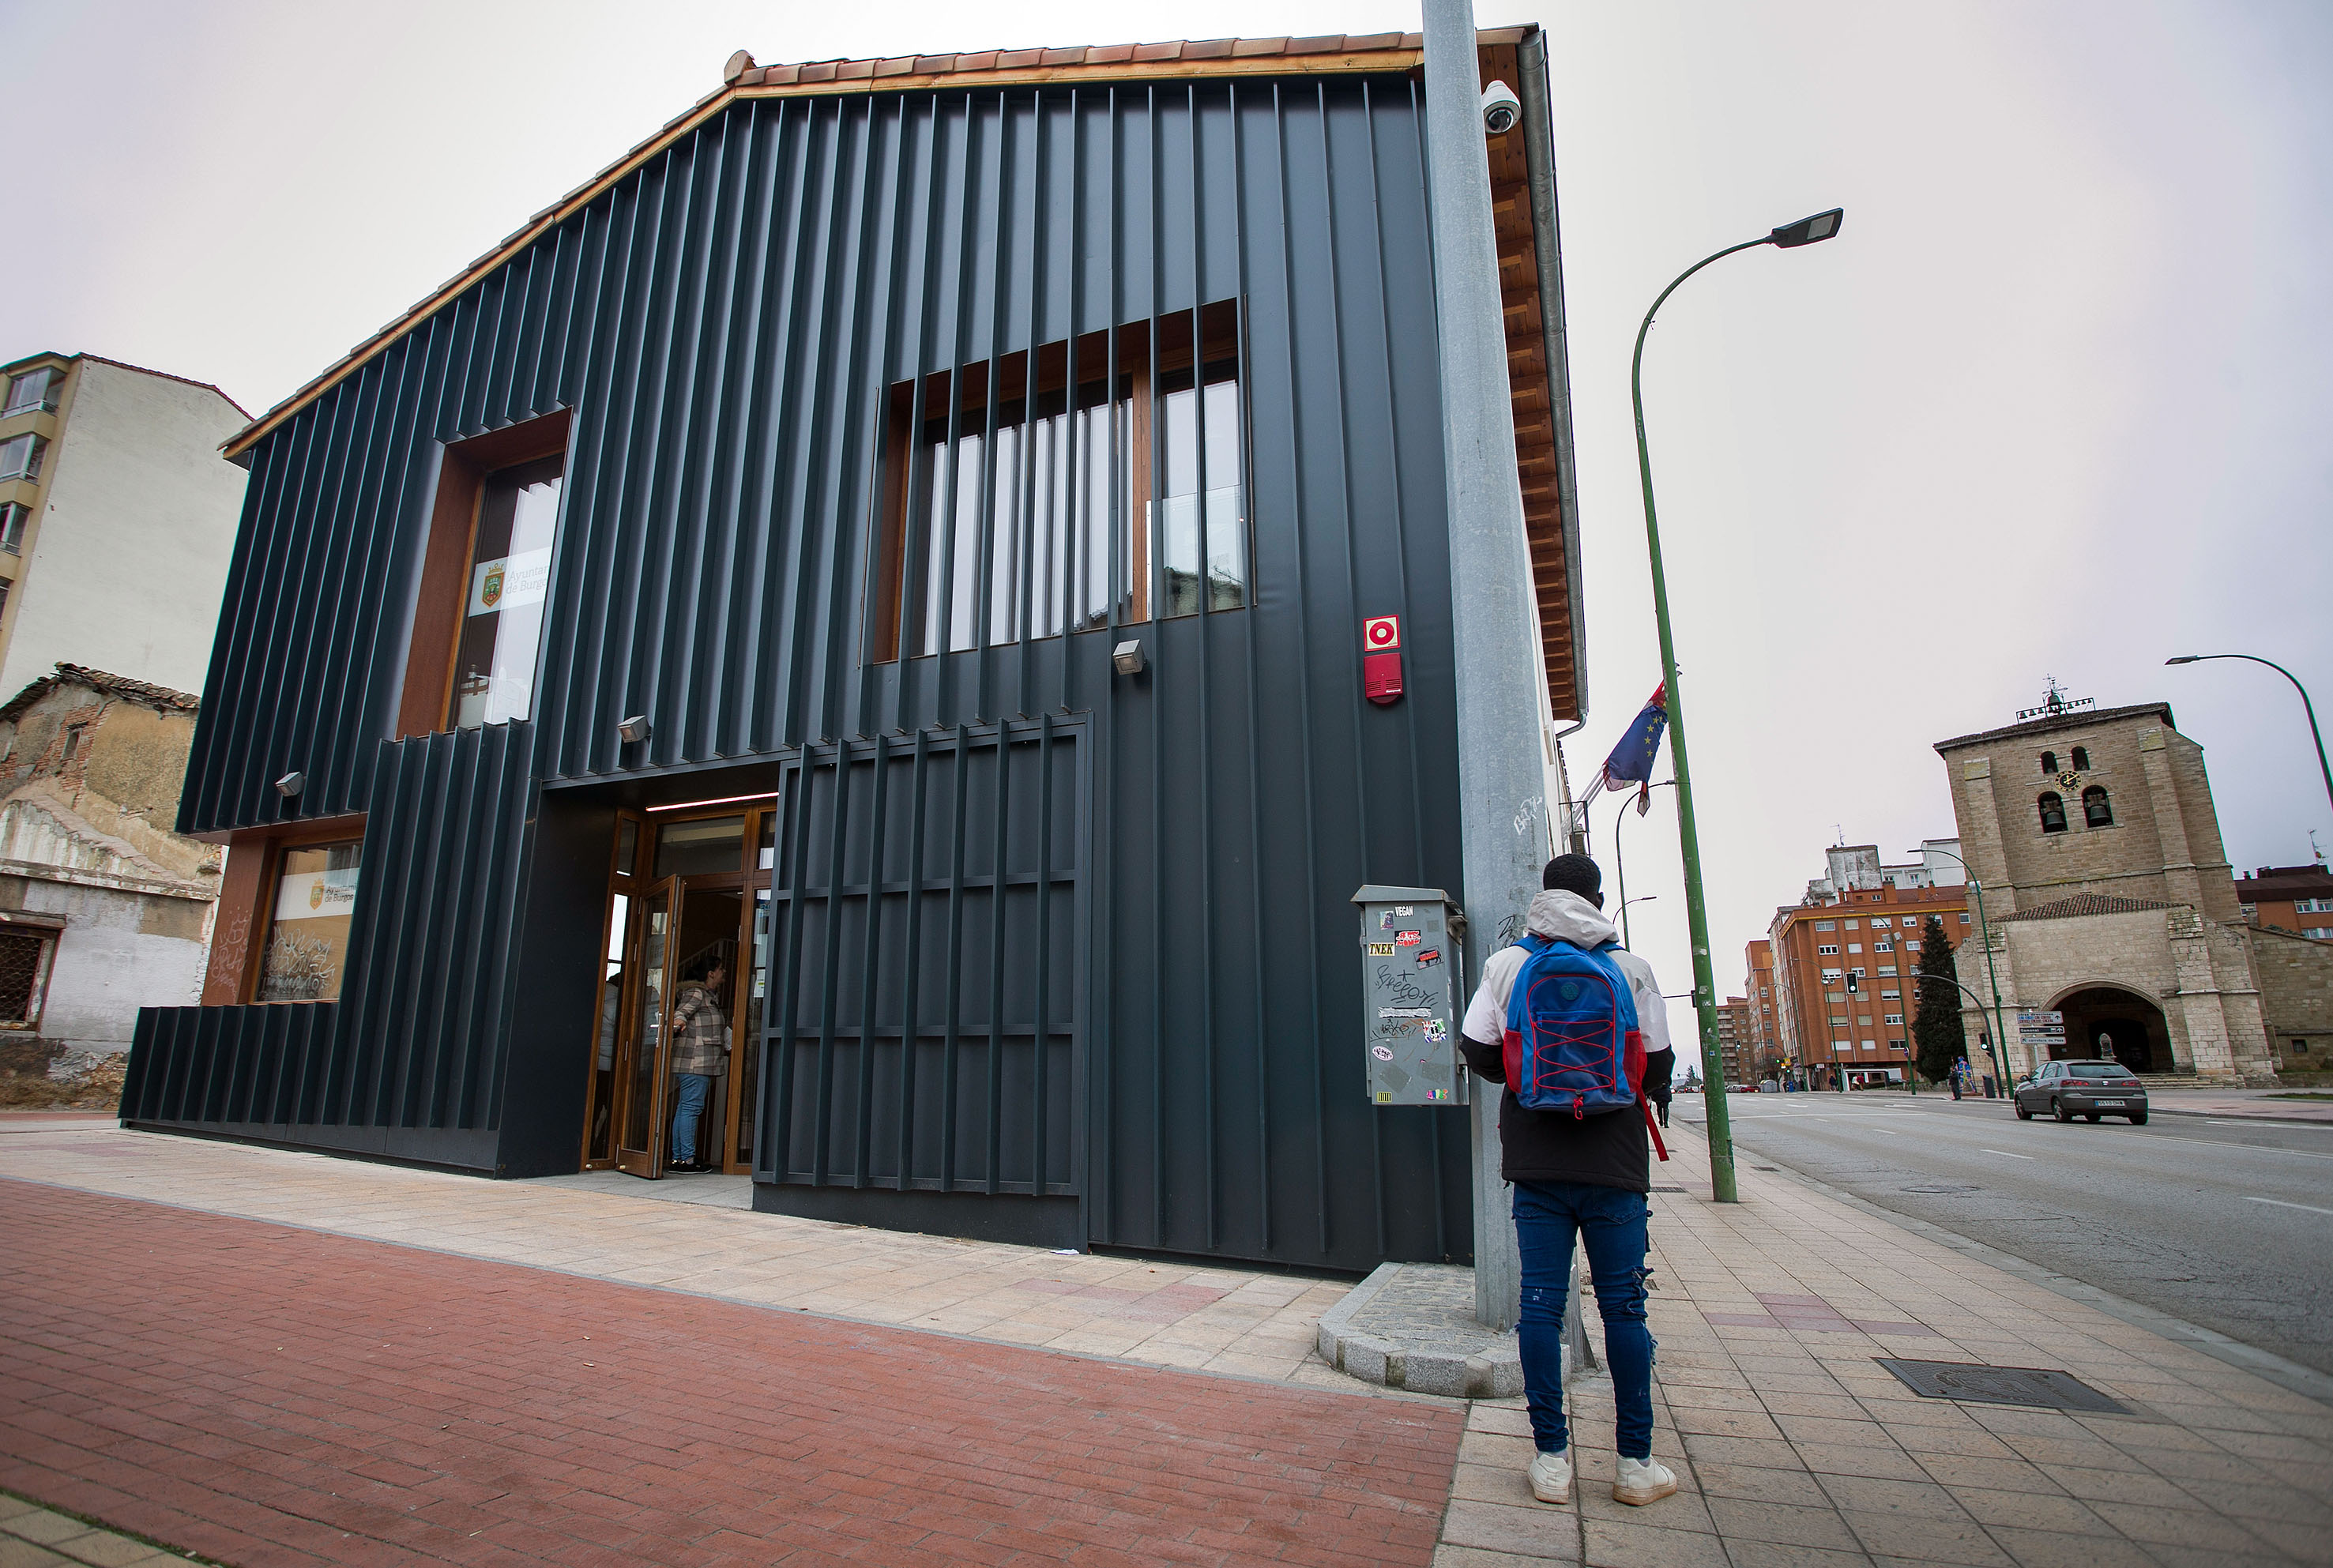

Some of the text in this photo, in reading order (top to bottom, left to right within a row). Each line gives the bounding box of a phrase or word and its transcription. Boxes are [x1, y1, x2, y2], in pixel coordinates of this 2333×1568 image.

[506, 581, 517, 594] de
[325, 893, 354, 903] de Burgos
[1394, 905, 1413, 916] VEGAN
[1369, 943, 1394, 955] TNEK
